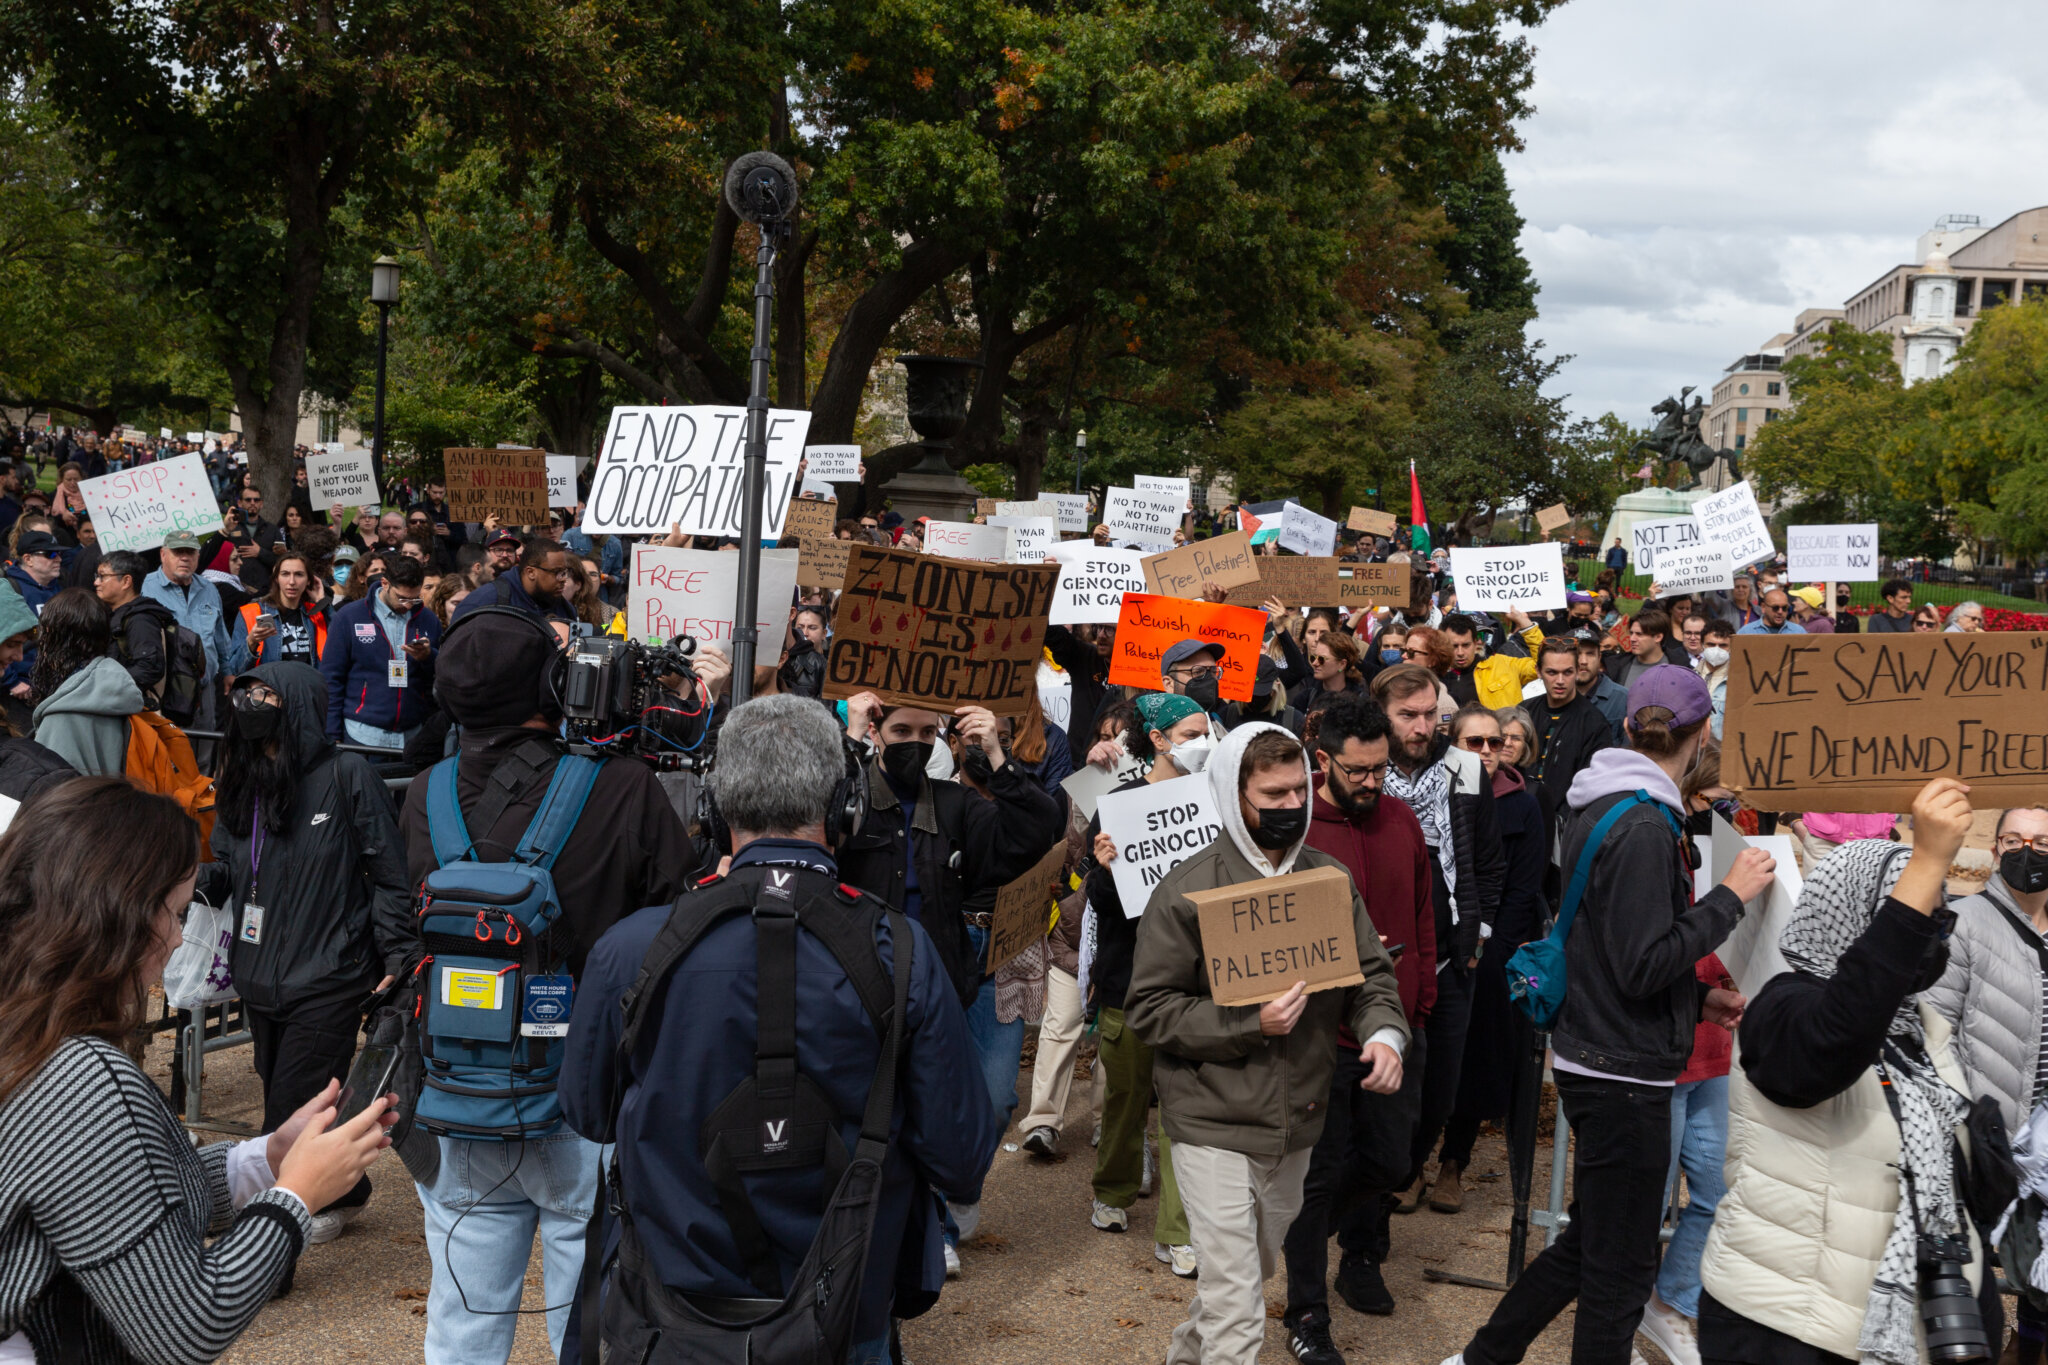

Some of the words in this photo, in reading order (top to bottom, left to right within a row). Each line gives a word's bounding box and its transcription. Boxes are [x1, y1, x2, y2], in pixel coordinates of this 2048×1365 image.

[607, 413, 697, 463] END
[318, 465, 330, 474] MY
[332, 462, 359, 473] GRIEF
[449, 453, 516, 467] AMERICAN
[520, 455, 546, 468] JEWS
[112, 466, 168, 499] STOP
[314, 478, 320, 487] IS
[322, 477, 339, 486] NOT
[342, 474, 369, 484] YOUR
[449, 468, 469, 482] SAY
[472, 468, 492, 488] NO
[495, 469, 544, 489] GENOCIDE
[322, 486, 362, 498] WEAPON
[451, 489, 460, 503] IN
[466, 489, 488, 504] OUR
[494, 489, 534, 506] NAME!
[792, 501, 816, 512] JEWS
[1002, 504, 1026, 516] SAY
[1033, 502, 1054, 516] NO
[1113, 498, 1128, 507] NO
[1132, 500, 1146, 509] TO
[1150, 503, 1175, 514] WAR
[1704, 498, 1727, 516] JEWS
[1730, 490, 1745, 505] SAY
[106, 501, 168, 528] Killing
[515, 508, 546, 524] NOW
[789, 516, 832, 527] AGAINST
[1125, 510, 1141, 519] NO
[1146, 512, 1159, 522] TO
[1704, 514, 1727, 530] STOP
[1728, 504, 1755, 521] KILLING
[929, 522, 972, 546] FREE
[1020, 528, 1045, 536] WAR
[1109, 520, 1171, 536] APARTHEID
[1634, 526, 1669, 546] NOT
[1676, 524, 1699, 542] IN
[1722, 522, 1756, 543] PEOPLE
[100, 526, 174, 552] Palestinian
[1017, 539, 1031, 547] TO
[1848, 535, 1870, 548] NOW
[1731, 538, 1766, 560] GAZA
[1086, 561, 1130, 574] STOP
[1484, 560, 1526, 572] STOP
[1660, 560, 1674, 568] NO
[1679, 558, 1692, 566] TO
[1697, 553, 1722, 562] WAR
[1848, 554, 1870, 568] NOW
[637, 550, 709, 593] FREE
[1152, 557, 1196, 596] Free
[1193, 544, 1250, 581] Palestine!
[1354, 568, 1382, 580] FREE
[1466, 572, 1549, 586] GENOCIDE
[1674, 568, 1690, 576] NO
[1694, 566, 1708, 574] TO
[847, 550, 1058, 619] ZIONISM
[1660, 574, 1724, 588] APARTHEID
[1072, 594, 1090, 606] IN
[1097, 594, 1121, 606] GA
[1341, 584, 1400, 598] PALESTINE
[1476, 589, 1492, 599] IN
[1497, 587, 1542, 599] GAZA
[646, 597, 770, 642] PALESTI
[1128, 600, 1190, 632] Jewish
[1199, 624, 1250, 642] woman
[920, 612, 975, 652] IS
[1124, 642, 1163, 660] Palest
[829, 638, 1032, 700] GENOCIDE
[1743, 644, 1820, 696] WE
[1834, 642, 1937, 702] SAW
[1944, 638, 2027, 697] YOUR
[1738, 730, 1798, 787] WE
[1810, 725, 1950, 780] DEMAND
[1957, 720, 2048, 776] FREE
[1118, 763, 1154, 782] STO
[1146, 802, 1199, 832] STOP
[1124, 824, 1221, 864] GENOCID
[1140, 865, 1162, 887] IN
[1232, 892, 1296, 934] FREE
[1212, 937, 1341, 986] PALESTINE
